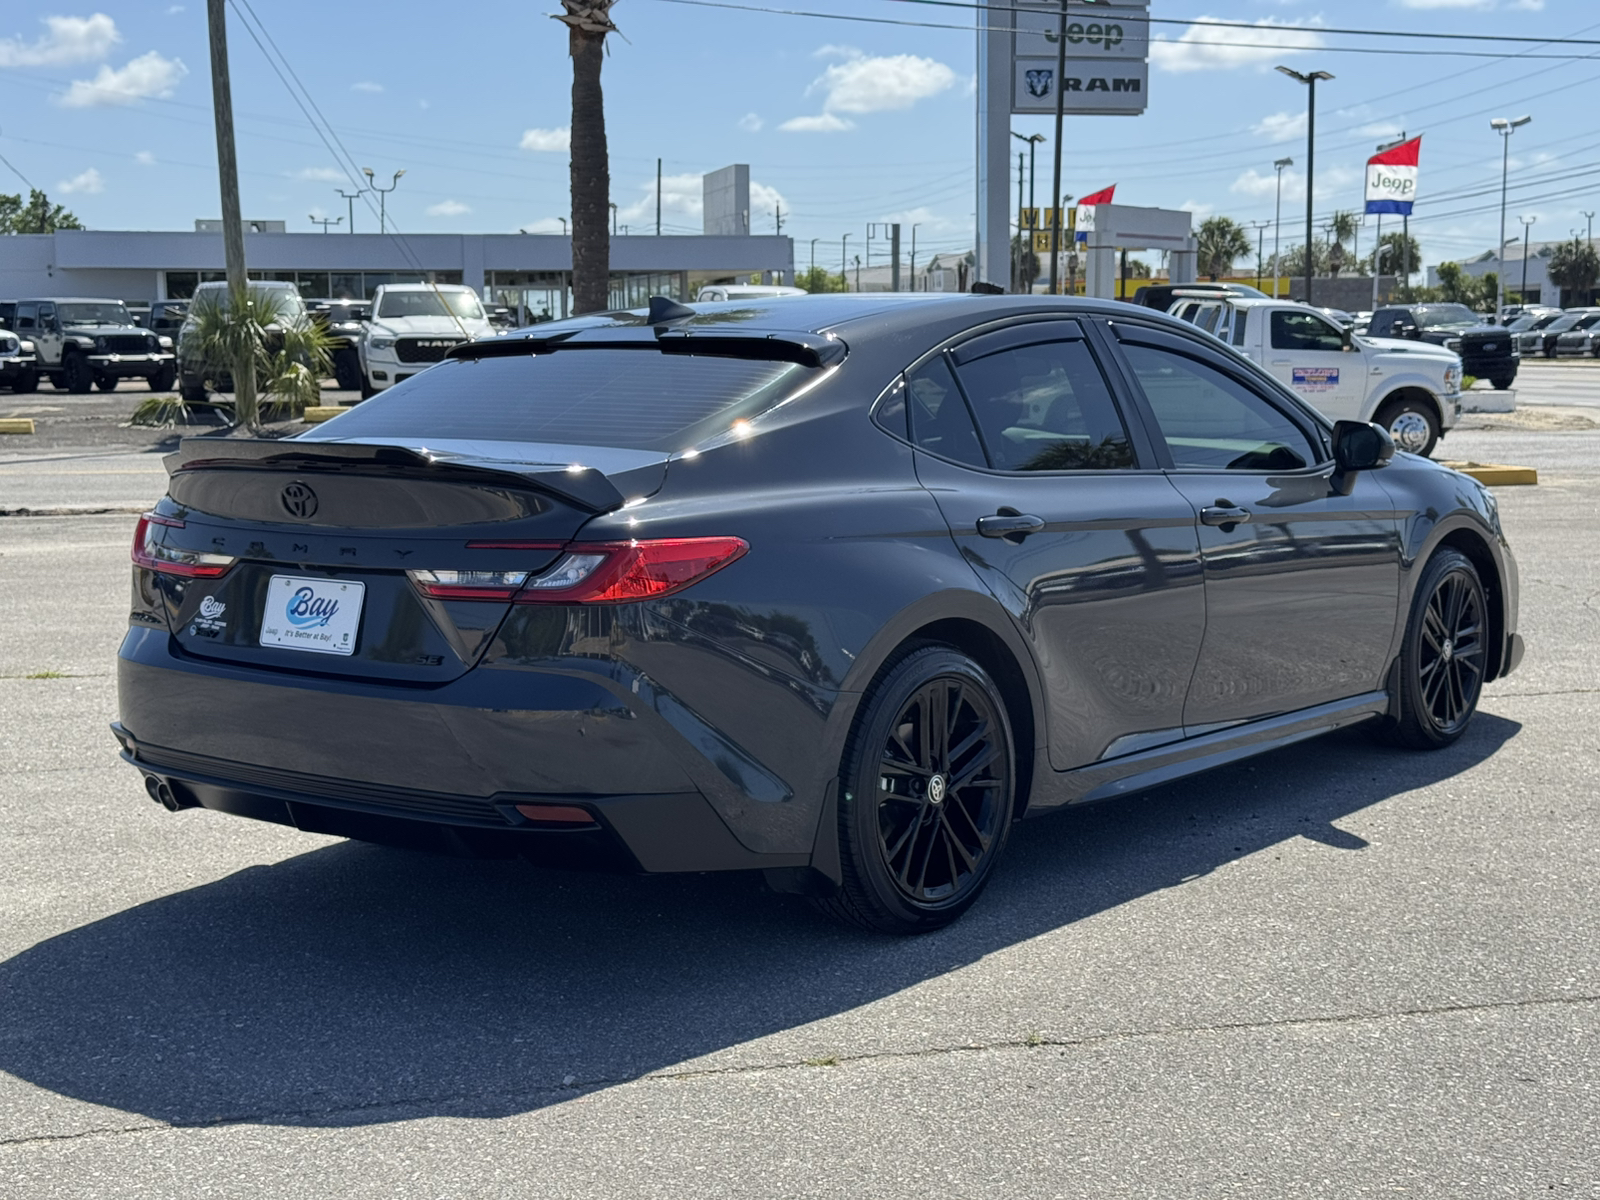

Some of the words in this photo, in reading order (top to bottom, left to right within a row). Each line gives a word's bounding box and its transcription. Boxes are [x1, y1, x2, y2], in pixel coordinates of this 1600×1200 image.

[1064, 78, 1141, 92] RAM
[1371, 172, 1413, 194] Jeep
[202, 595, 226, 618] Bay
[290, 586, 339, 627] Bay
[295, 630, 312, 639] Better
[415, 655, 444, 666] SE
